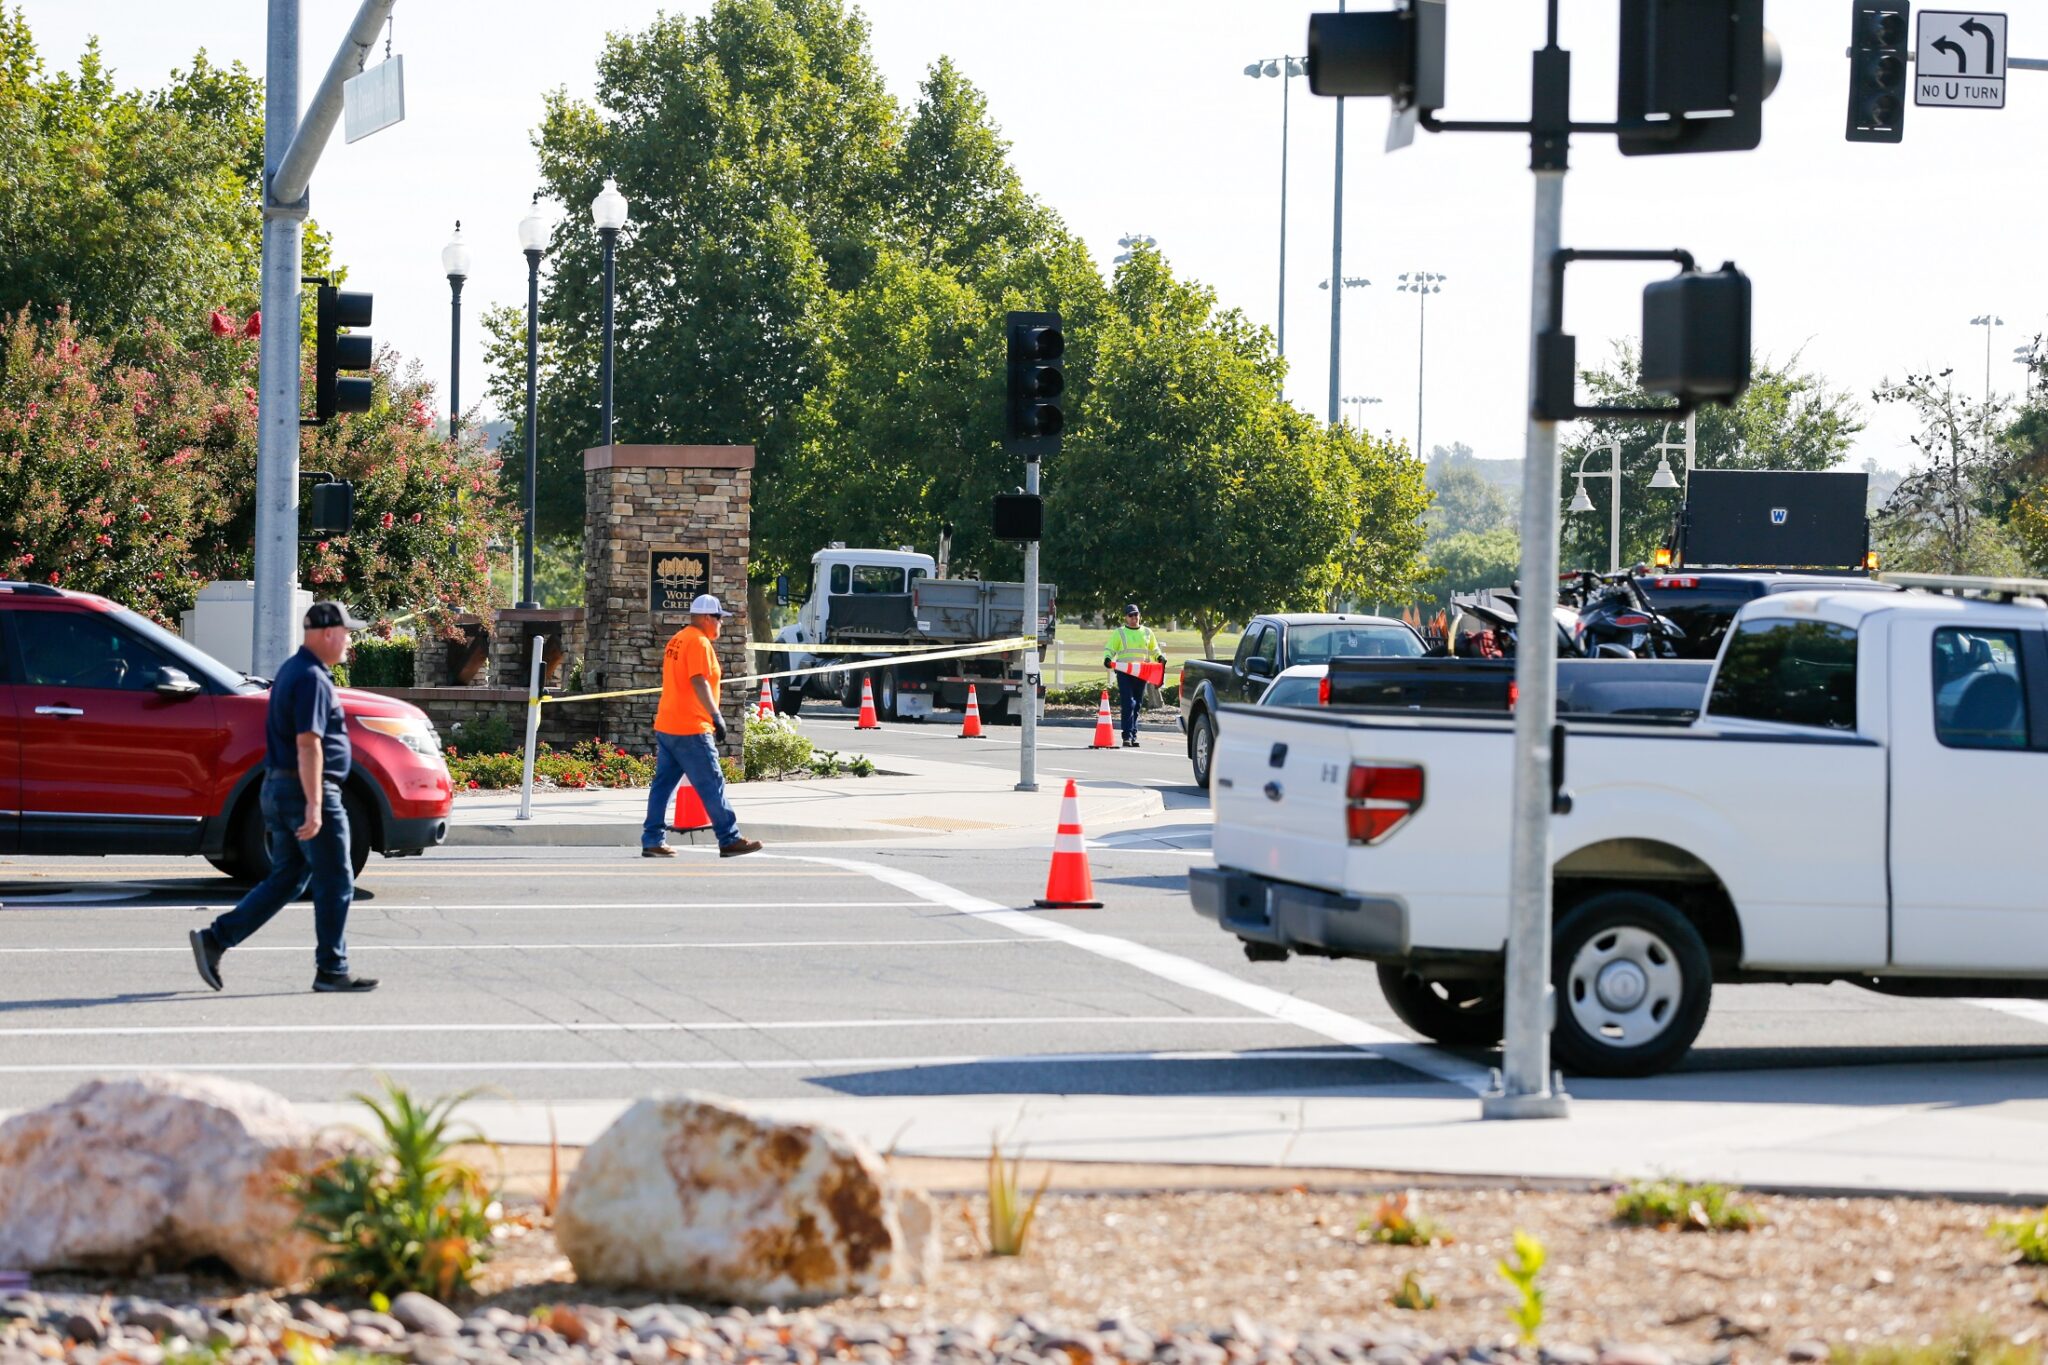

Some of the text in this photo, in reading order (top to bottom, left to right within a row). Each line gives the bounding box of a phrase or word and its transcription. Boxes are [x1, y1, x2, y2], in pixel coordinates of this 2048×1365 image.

[1922, 82, 1998, 100] NO U TURN
[665, 590, 695, 599] WOLF
